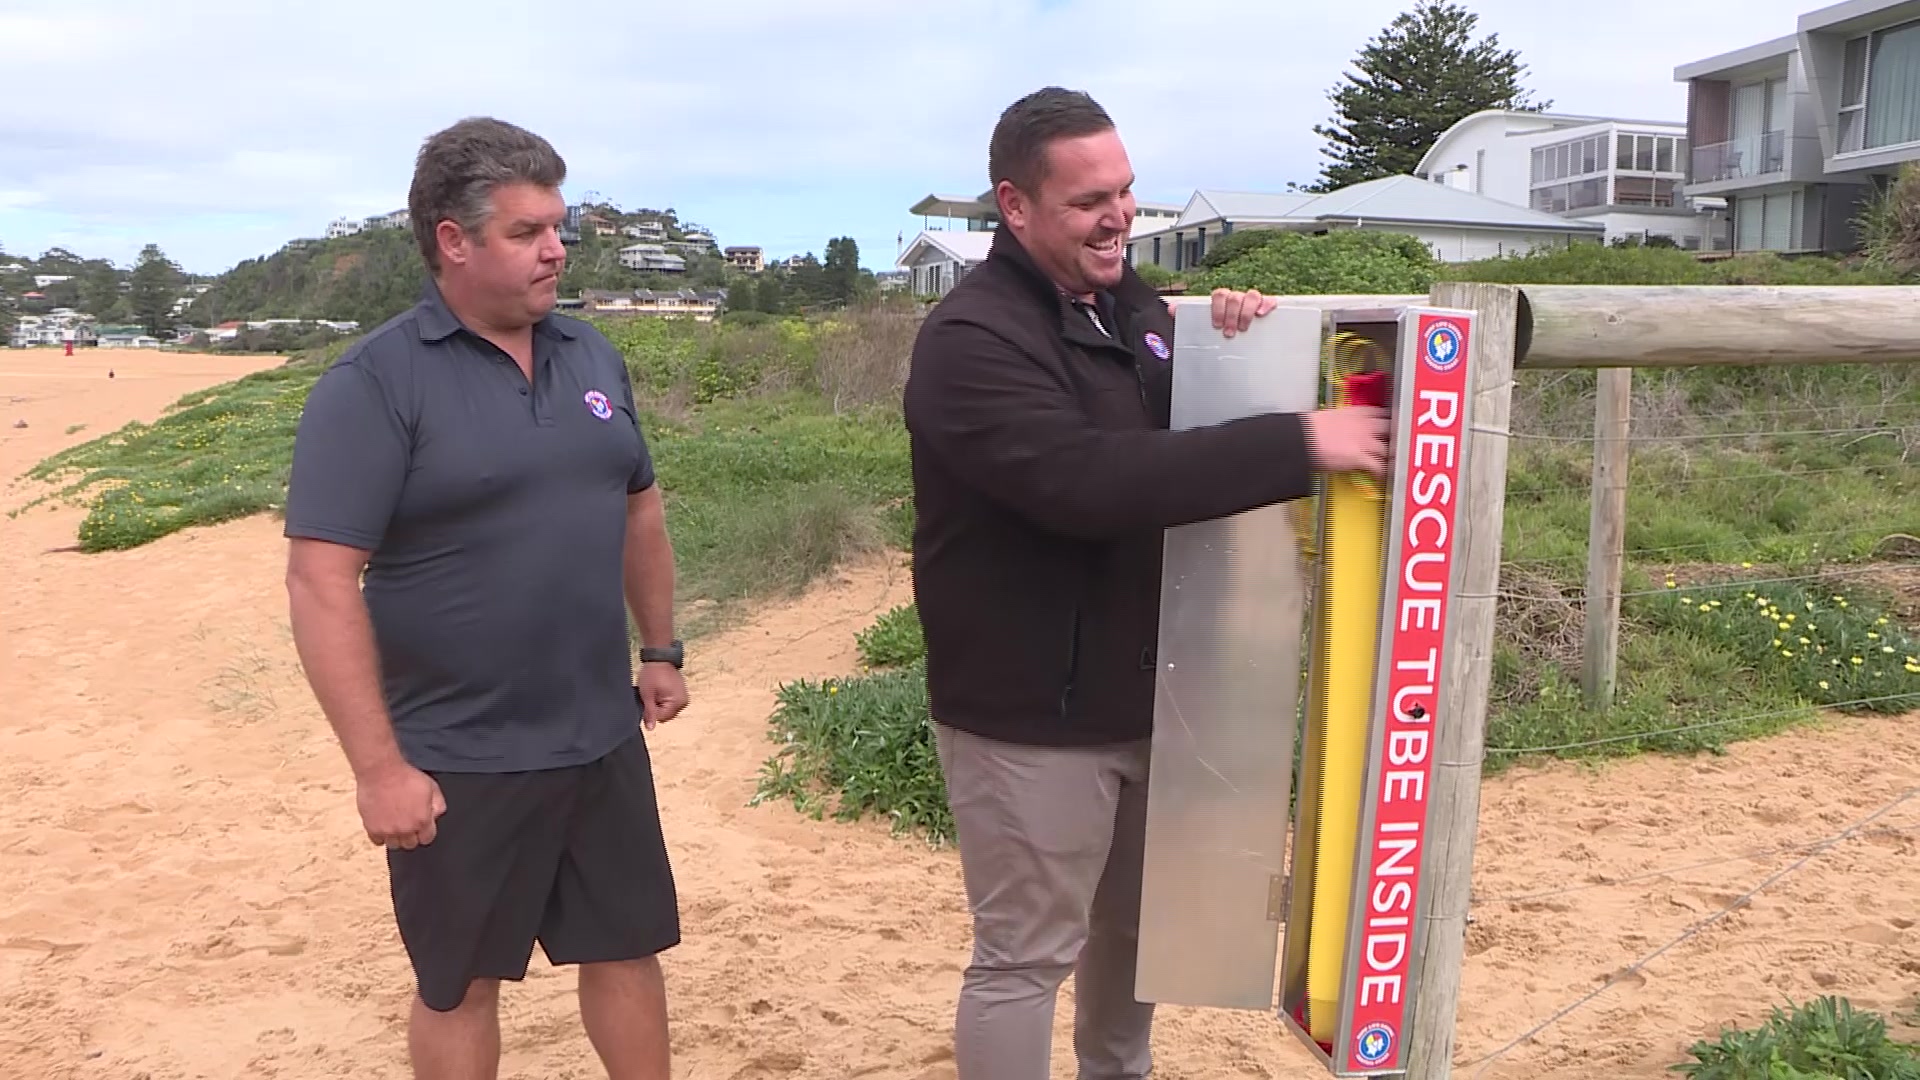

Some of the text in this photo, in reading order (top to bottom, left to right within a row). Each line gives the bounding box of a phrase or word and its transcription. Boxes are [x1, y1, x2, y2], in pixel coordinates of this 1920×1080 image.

[1401, 390, 1459, 631] RESCUE
[1384, 648, 1437, 803] TUBE
[1361, 823, 1419, 1006] INSIDE
